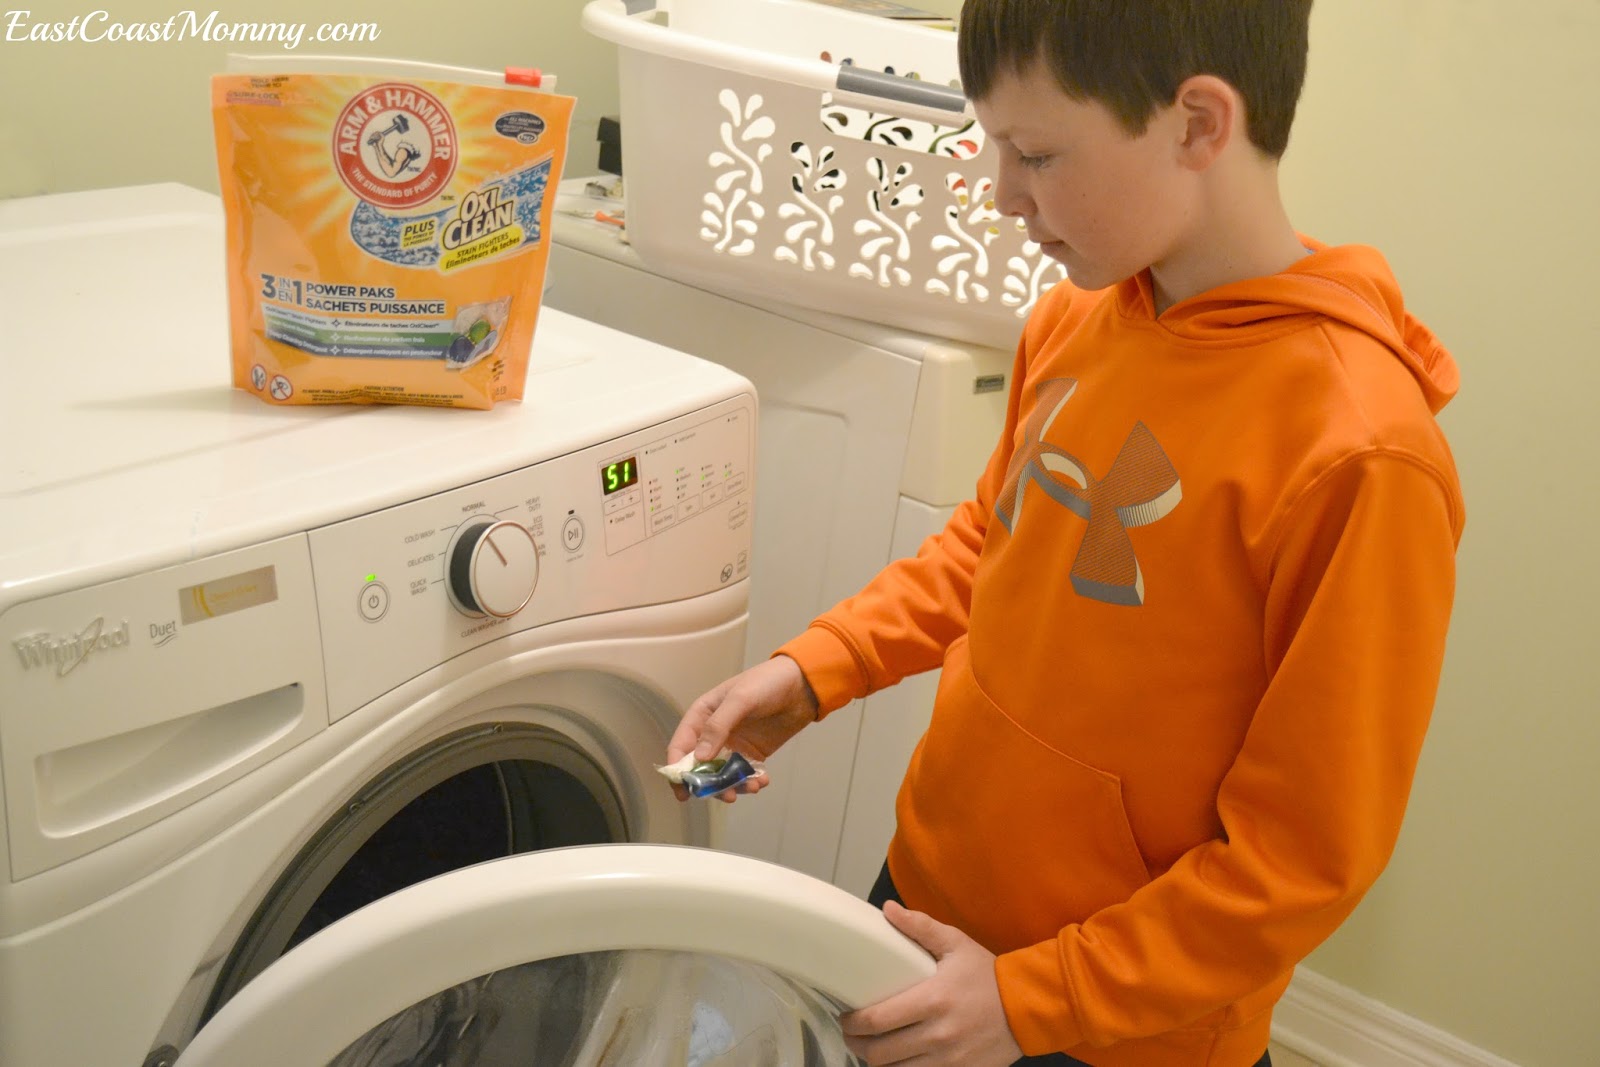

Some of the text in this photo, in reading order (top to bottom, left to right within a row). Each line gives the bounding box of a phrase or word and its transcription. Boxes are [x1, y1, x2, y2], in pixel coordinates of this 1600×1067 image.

[340, 89, 452, 160] ARM & HAMMER
[363, 178, 403, 199] STANDARD
[460, 187, 500, 222] OXI
[403, 220, 435, 237] PLUS
[443, 200, 514, 251] CLEAN
[456, 232, 510, 258] STAIN FIGHTERS
[260, 273, 276, 299] 3
[279, 277, 291, 289] IN
[292, 280, 303, 305] 1
[306, 282, 395, 299] POWER PAKS
[278, 290, 293, 303] EN
[306, 297, 446, 315] SACHETS PUISSANCE
[606, 462, 630, 491] 51
[461, 501, 486, 513] NORMAL
[404, 533, 420, 544] COLD
[407, 553, 435, 568] DELICATES
[149, 620, 177, 639] Duet
